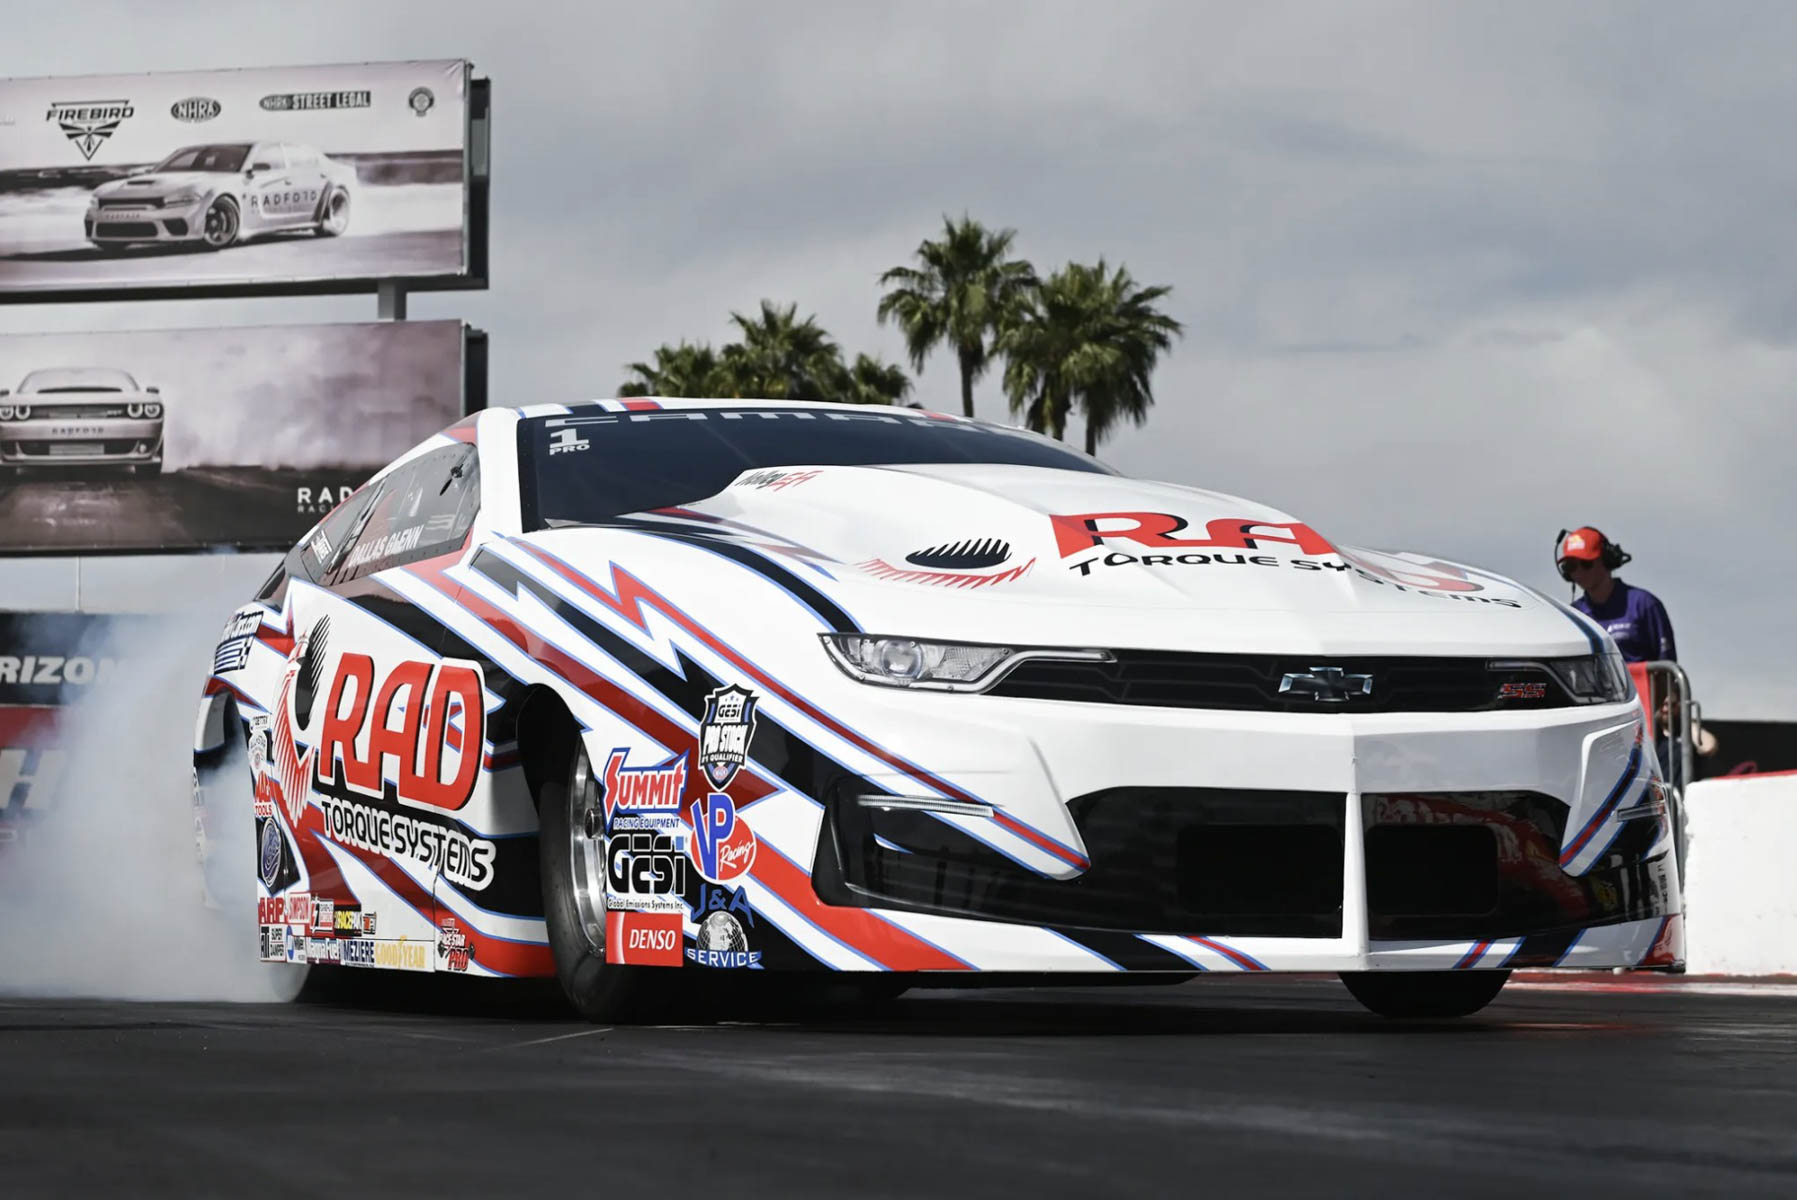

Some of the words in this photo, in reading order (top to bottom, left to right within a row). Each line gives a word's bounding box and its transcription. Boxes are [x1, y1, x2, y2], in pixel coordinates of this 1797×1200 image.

[176, 101, 217, 118] NHRA
[292, 92, 331, 109] STREET
[336, 91, 369, 107] LEGAL
[46, 107, 134, 121] FIREBIRD
[550, 428, 589, 447] 1
[549, 443, 590, 455] PRO
[297, 505, 334, 513] RAC
[347, 535, 388, 567] DALLAS
[384, 524, 424, 557] GLENN
[1069, 552, 1279, 576] TORQUE
[1291, 559, 1522, 608] SYSTEMS
[319, 652, 485, 811] RAD
[719, 725, 748, 756] STOCK
[710, 753, 743, 763] QUALIFIER
[255, 804, 273, 816] TOOLS
[613, 817, 640, 830] RACING
[640, 816, 680, 829] EQUIPMENT
[690, 792, 736, 881] VP
[720, 839, 755, 872] Racing
[258, 897, 285, 923] ARP
[608, 898, 625, 909] Global
[625, 899, 650, 909] Emissions
[651, 900, 674, 911] Systems
[690, 883, 755, 928] J&A
[629, 929, 676, 950] DENSO
[686, 948, 760, 967] SERVICE
